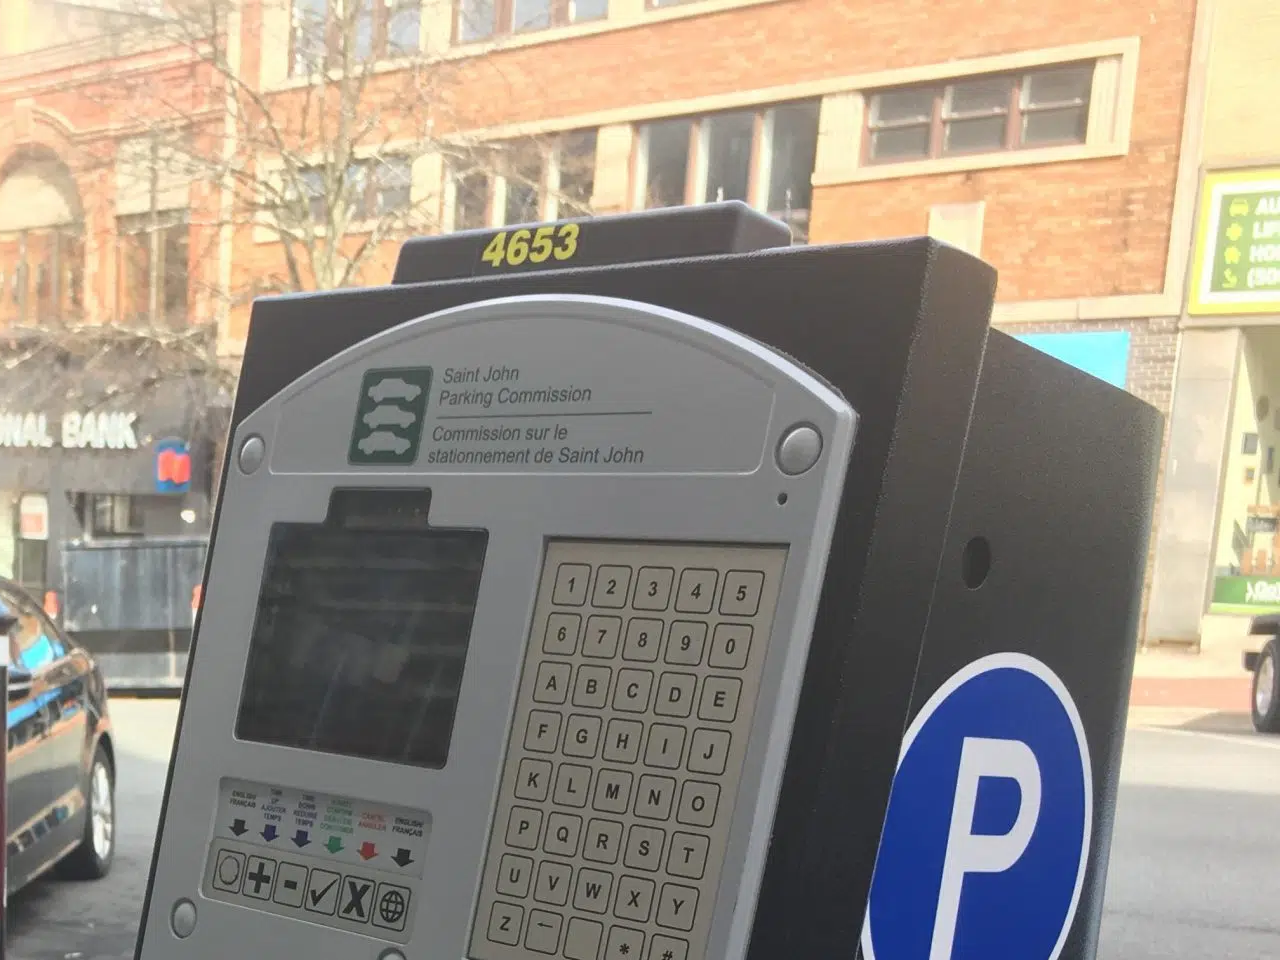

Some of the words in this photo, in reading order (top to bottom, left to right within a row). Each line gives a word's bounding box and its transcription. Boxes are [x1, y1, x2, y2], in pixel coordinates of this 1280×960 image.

[481, 222, 580, 269] 4653
[443, 367, 480, 384] Saint
[483, 366, 520, 382] John
[439, 388, 493, 408] Parking
[497, 385, 592, 404] Commission
[62, 410, 138, 449] BANK
[432, 424, 521, 442] Commission
[525, 427, 551, 441] sur
[554, 424, 568, 441] le
[427, 448, 532, 465] stationnement
[534, 447, 553, 464] de
[558, 446, 600, 464] Saint
[603, 444, 644, 464] John
[568, 577, 575, 593] 1
[606, 579, 616, 595] 2
[648, 581, 658, 597] 3
[691, 583, 701, 599] 4
[736, 585, 747, 601] 5
[557, 626, 567, 642] 6
[598, 629, 607, 644] 7
[637, 632, 648, 648] 8
[681, 635, 691, 651] 9
[725, 638, 735, 655] 0
[545, 675, 557, 691] A
[586, 679, 597, 694] B
[627, 683, 639, 698] C
[668, 687, 681, 703] D
[713, 691, 726, 708] E
[537, 724, 548, 739] F
[576, 728, 588, 744] G
[616, 733, 629, 750] H
[662, 738, 668, 754] I
[703, 744, 714, 760] J
[527, 772, 540, 788] K
[567, 777, 576, 794] L
[605, 783, 620, 800] M
[648, 789, 661, 806] N
[692, 796, 705, 812] O
[518, 820, 529, 835] P
[557, 826, 569, 843] Q
[596, 833, 609, 850] R
[638, 840, 650, 856] S
[683, 847, 694, 863] T
[509, 868, 520, 883] U
[549, 875, 560, 891] V
[586, 882, 602, 899] W
[627, 890, 641, 907] X
[673, 898, 685, 915] Y
[499, 916, 511, 931] Z
